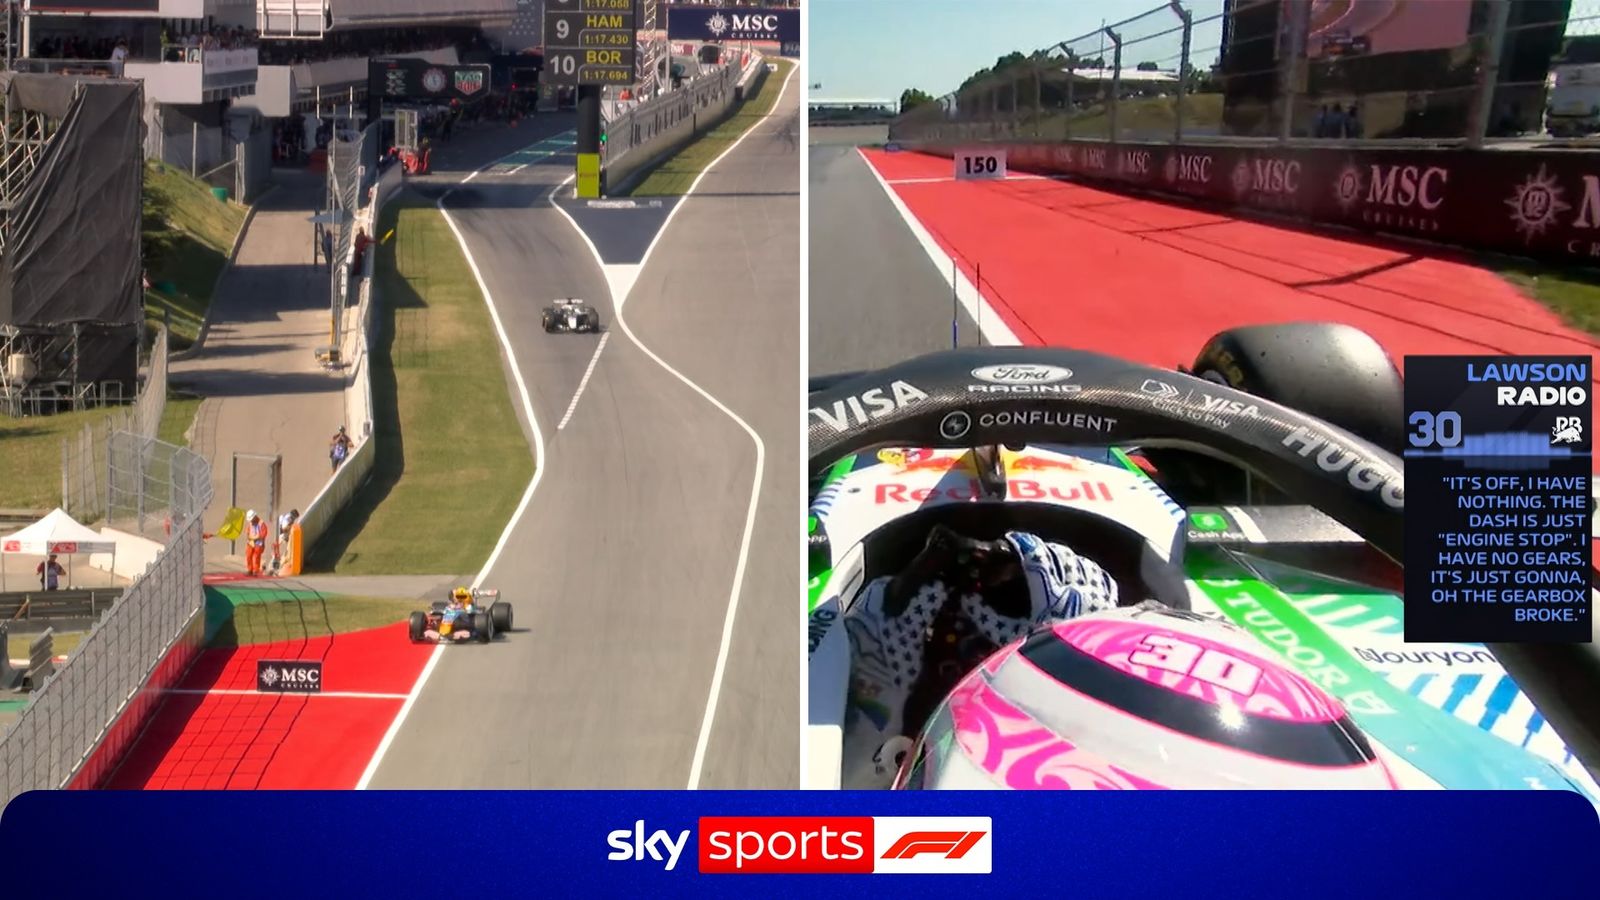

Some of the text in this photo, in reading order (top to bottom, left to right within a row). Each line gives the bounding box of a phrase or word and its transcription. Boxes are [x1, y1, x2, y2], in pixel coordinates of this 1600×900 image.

[556, 19, 569, 39] 9
[586, 15, 622, 28] HAM
[731, 14, 778, 31] MSC
[585, 34, 628, 44] 1:17.430
[550, 55, 575, 75] 10
[586, 50, 622, 64] BOR
[584, 71, 628, 80] 1:17.694
[963, 156, 998, 175] 150
[1127, 151, 1150, 174] MSC
[1178, 154, 1212, 184] MSC
[1252, 159, 1301, 193] MSC
[1365, 164, 1448, 210] MSC
[992, 367, 1050, 380] Ford
[967, 384, 1082, 393] RACING
[810, 380, 929, 433] VISA
[1203, 393, 1260, 420] VISA
[978, 410, 1118, 433] CONFLUENT
[875, 479, 1114, 504] Red Bull
[1224, 592, 1350, 688] TUDOR
[1128, 632, 1264, 698] 30
[1353, 646, 1496, 667] Nouryon
[281, 668, 319, 683] MSC
